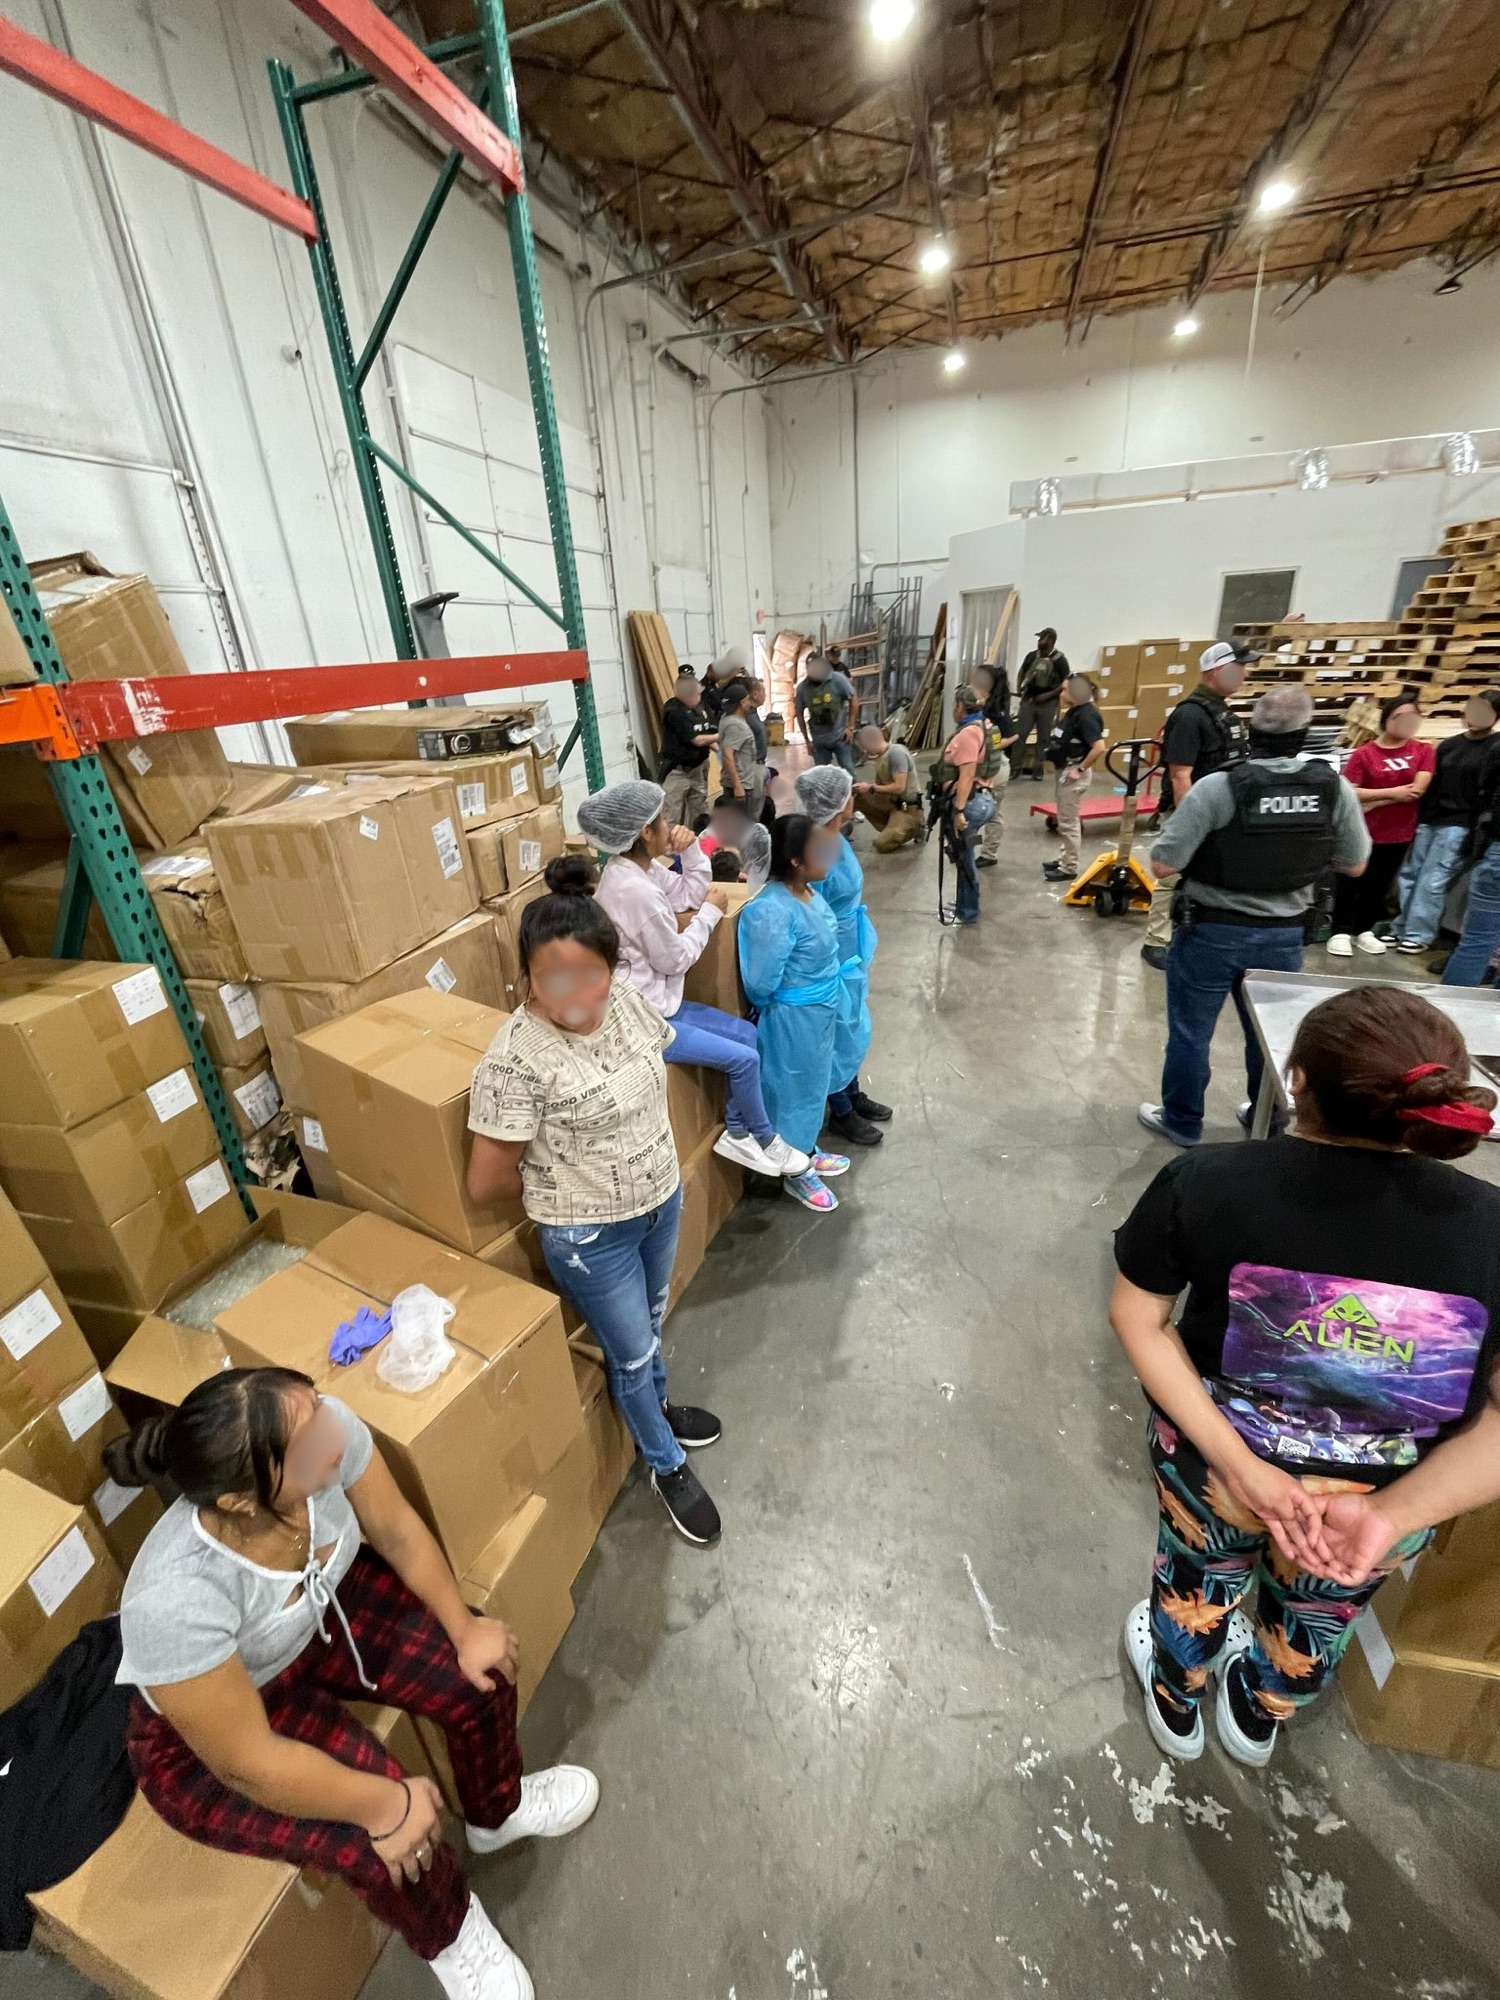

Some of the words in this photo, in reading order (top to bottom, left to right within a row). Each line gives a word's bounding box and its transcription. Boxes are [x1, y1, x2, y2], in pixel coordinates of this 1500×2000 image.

[1259, 795, 1320, 814] POLICE
[627, 1145, 655, 1165] GOOD
[610, 1164, 623, 1202] AMAZING
[1283, 1320, 1415, 1363] ALIEN
